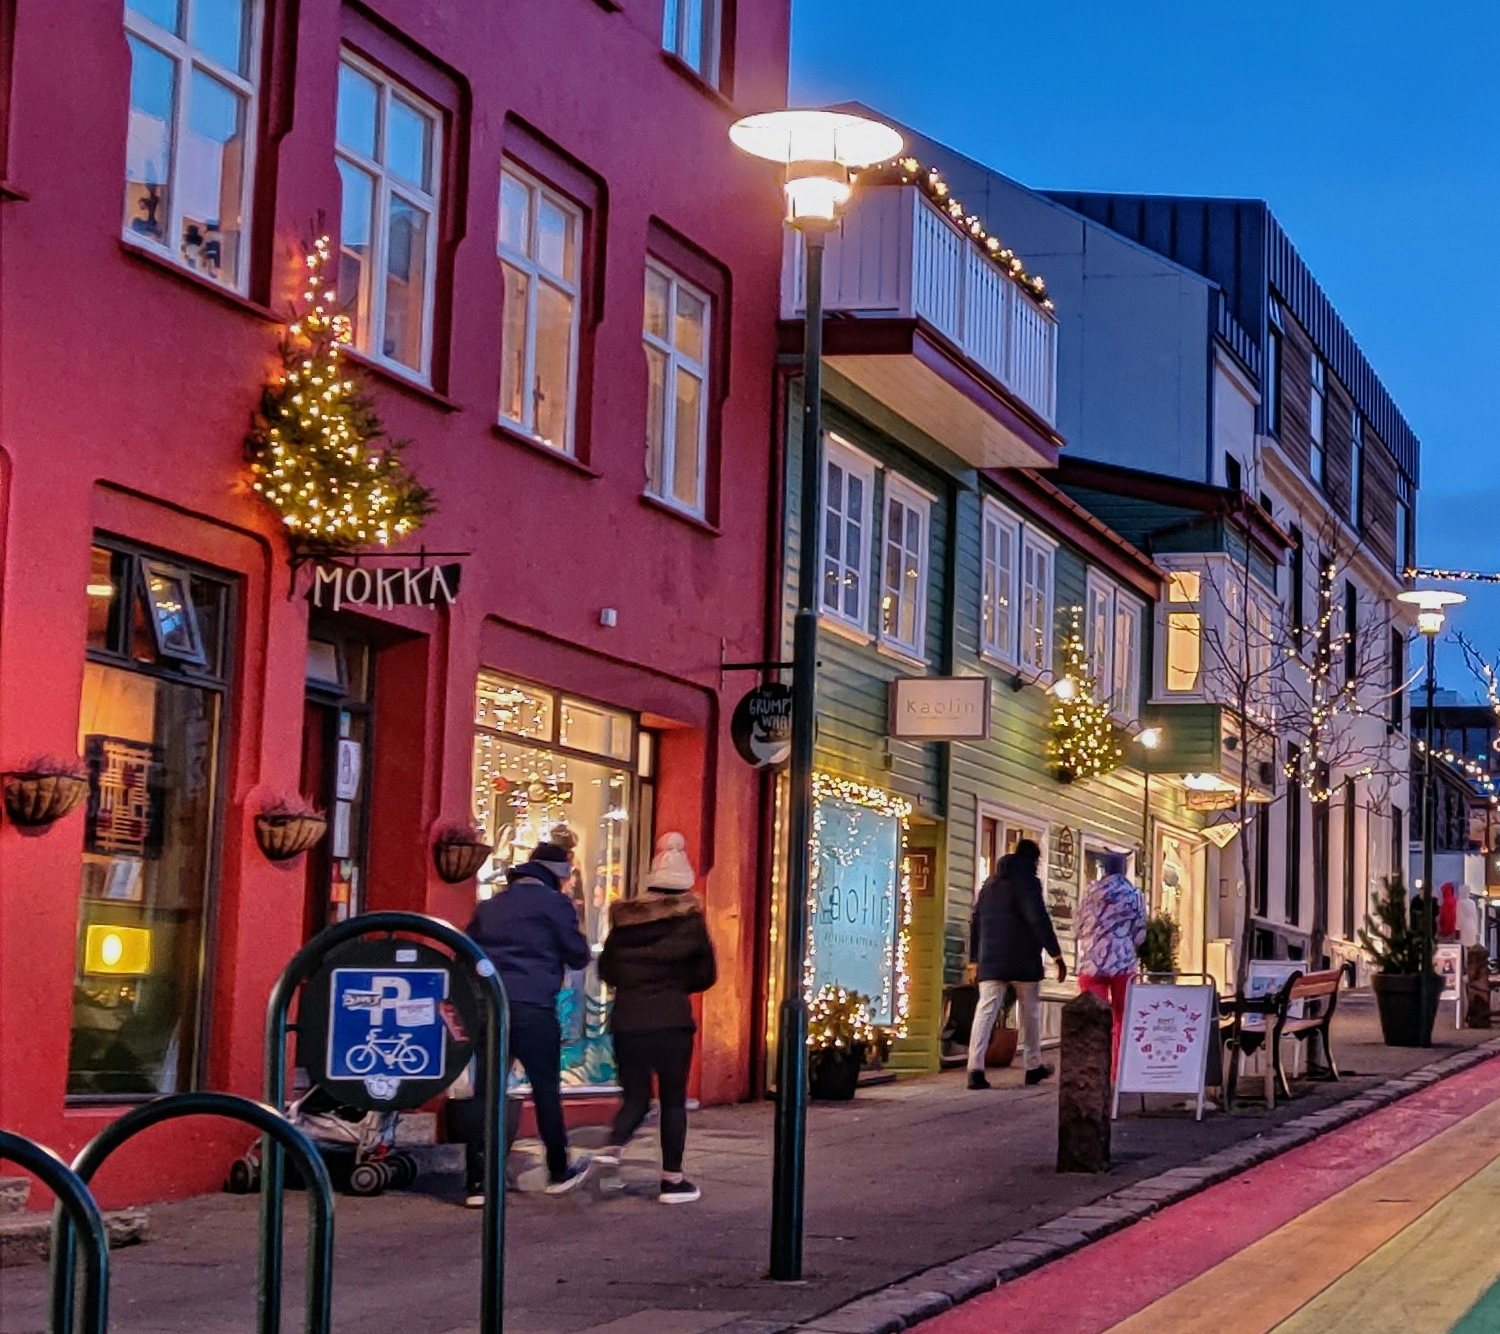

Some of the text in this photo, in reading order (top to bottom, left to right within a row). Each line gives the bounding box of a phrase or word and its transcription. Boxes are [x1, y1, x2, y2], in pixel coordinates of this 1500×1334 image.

[314, 565, 456, 611] MOKKA
[749, 698, 792, 715] GRUMP
[906, 698, 974, 714] Kaolin
[370, 976, 412, 1026] P
